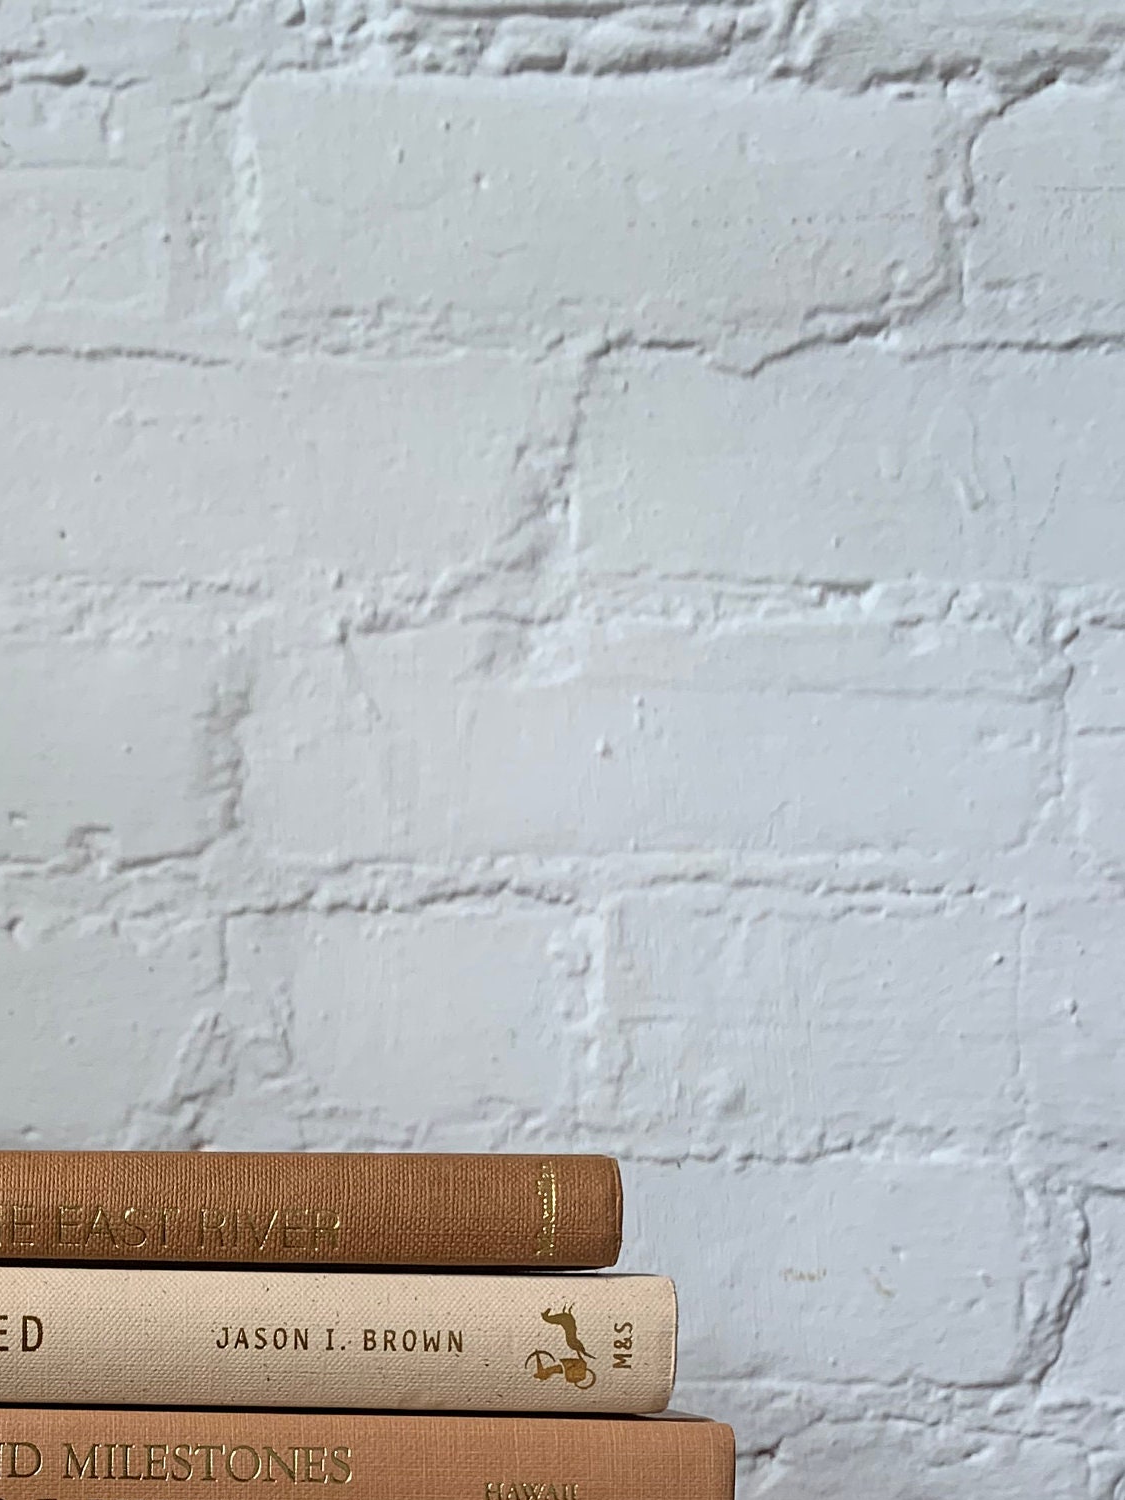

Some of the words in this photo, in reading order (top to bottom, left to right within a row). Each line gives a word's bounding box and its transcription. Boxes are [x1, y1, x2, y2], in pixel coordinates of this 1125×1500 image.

[57, 1205, 180, 1250] EAST
[197, 1207, 341, 1252] RIVER
[216, 1326, 309, 1351] JASON
[325, 1328, 347, 1352] I.
[363, 1329, 465, 1354] BROWN
[612, 1320, 634, 1370] M&S
[62, 1442, 353, 1485] MILESTONES
